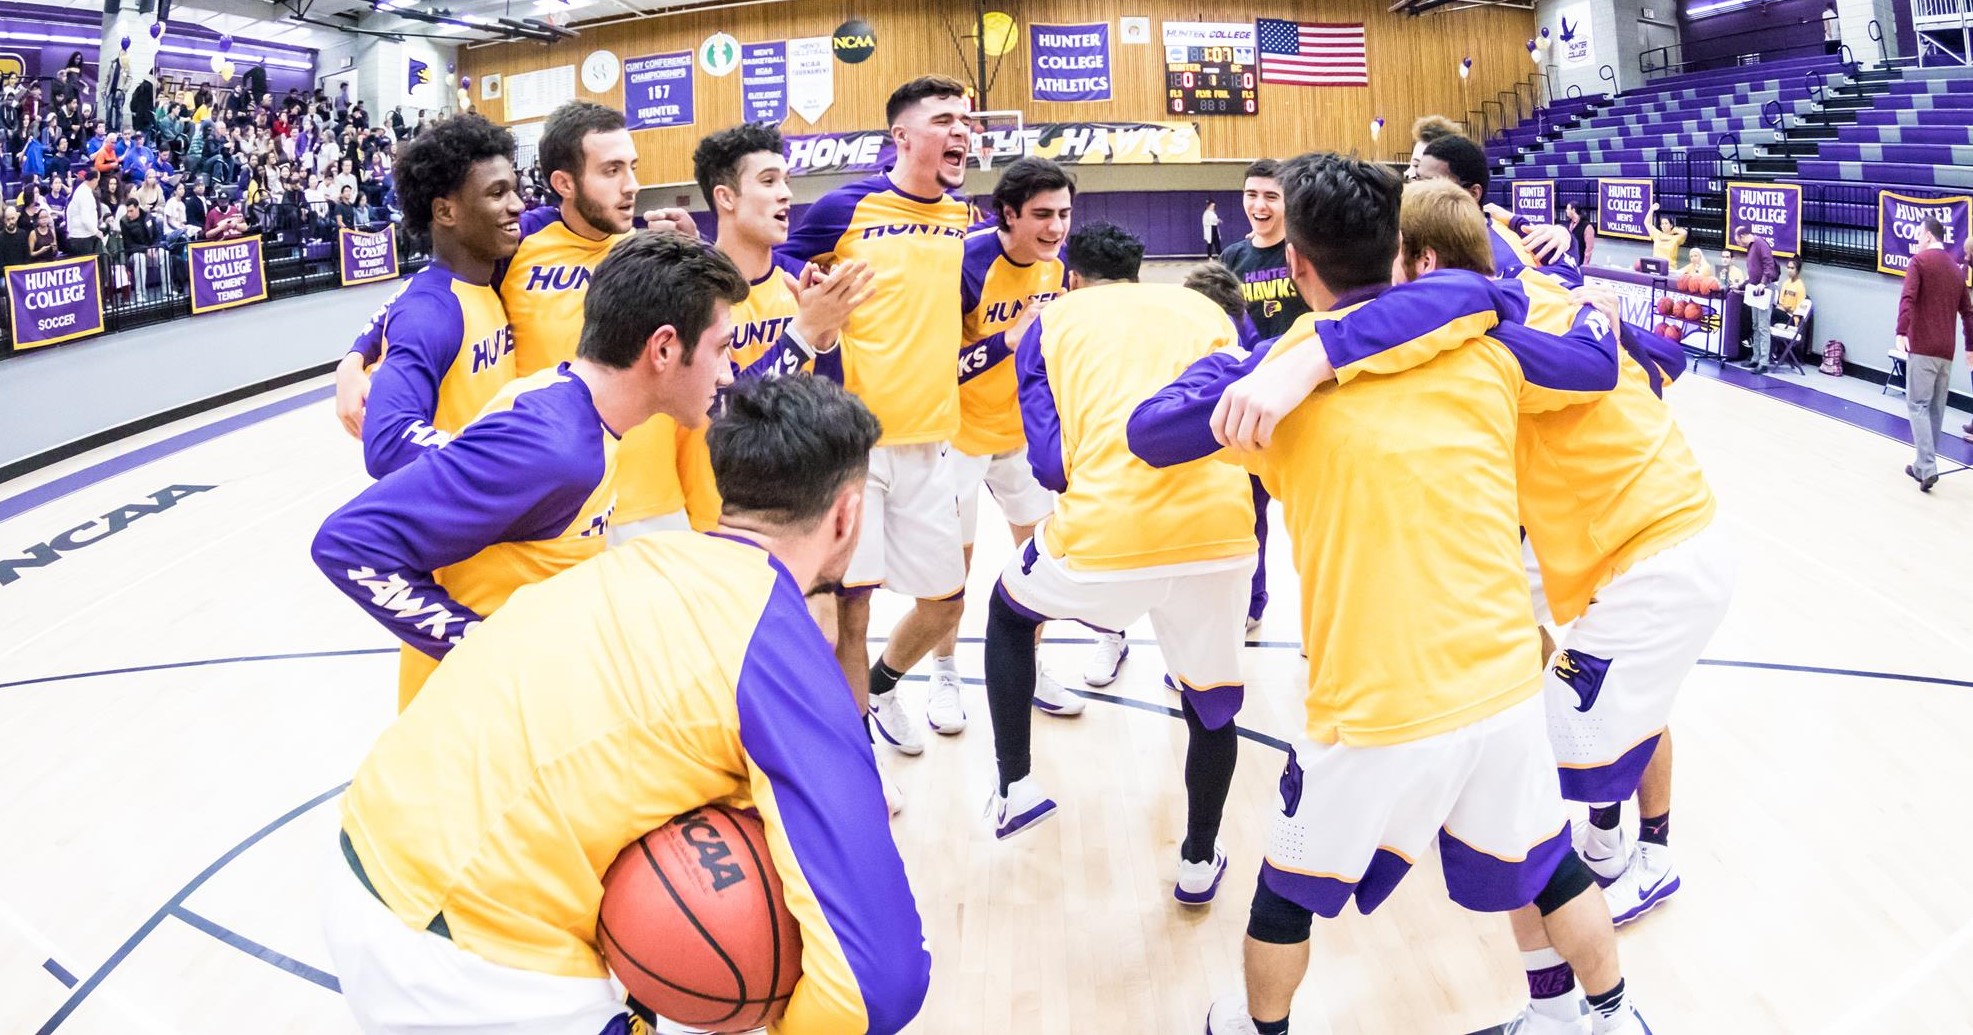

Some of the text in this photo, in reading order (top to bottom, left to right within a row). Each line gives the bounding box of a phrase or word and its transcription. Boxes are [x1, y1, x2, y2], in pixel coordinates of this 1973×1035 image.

[1038, 33, 1101, 48] HUNTER
[1209, 30, 1252, 39] COLLEGE
[833, 35, 875, 50] NCAA
[626, 55, 691, 72] CUNY CONFERENCE
[1037, 55, 1104, 70] COLLEGE
[1035, 77, 1108, 93] ATHLETICS
[1183, 71, 1194, 88] 0
[1243, 72, 1254, 89] 0
[648, 84, 670, 100] 157
[638, 105, 680, 118] HUNTER
[1174, 98, 1254, 113] 0 0
[788, 136, 884, 168] HOME
[1060, 127, 1192, 156] HAWKS
[1519, 187, 1545, 197] HUNTER
[1608, 185, 1641, 198] HUNTER
[1740, 190, 1785, 206] HUNTER
[1519, 198, 1547, 209] COLLEGE
[1607, 198, 1643, 213] COLLEGE
[1616, 213, 1633, 222] MEN'S
[1738, 206, 1787, 224] COLLEGE
[1607, 221, 1642, 234] VOLLEYBALL
[1751, 224, 1773, 235] MEN'S
[203, 243, 249, 264] HUNTER
[203, 259, 252, 280] COLLEGE
[1244, 266, 1287, 283] HUNTE
[25, 266, 83, 290] HUNTER
[212, 275, 247, 290] WOMEN'S
[525, 265, 592, 291] HUN
[25, 284, 86, 310] COLLEGE
[216, 288, 244, 302] TENNIS
[37, 313, 76, 331] SOCCER
[0, 485, 220, 586] NCAA
